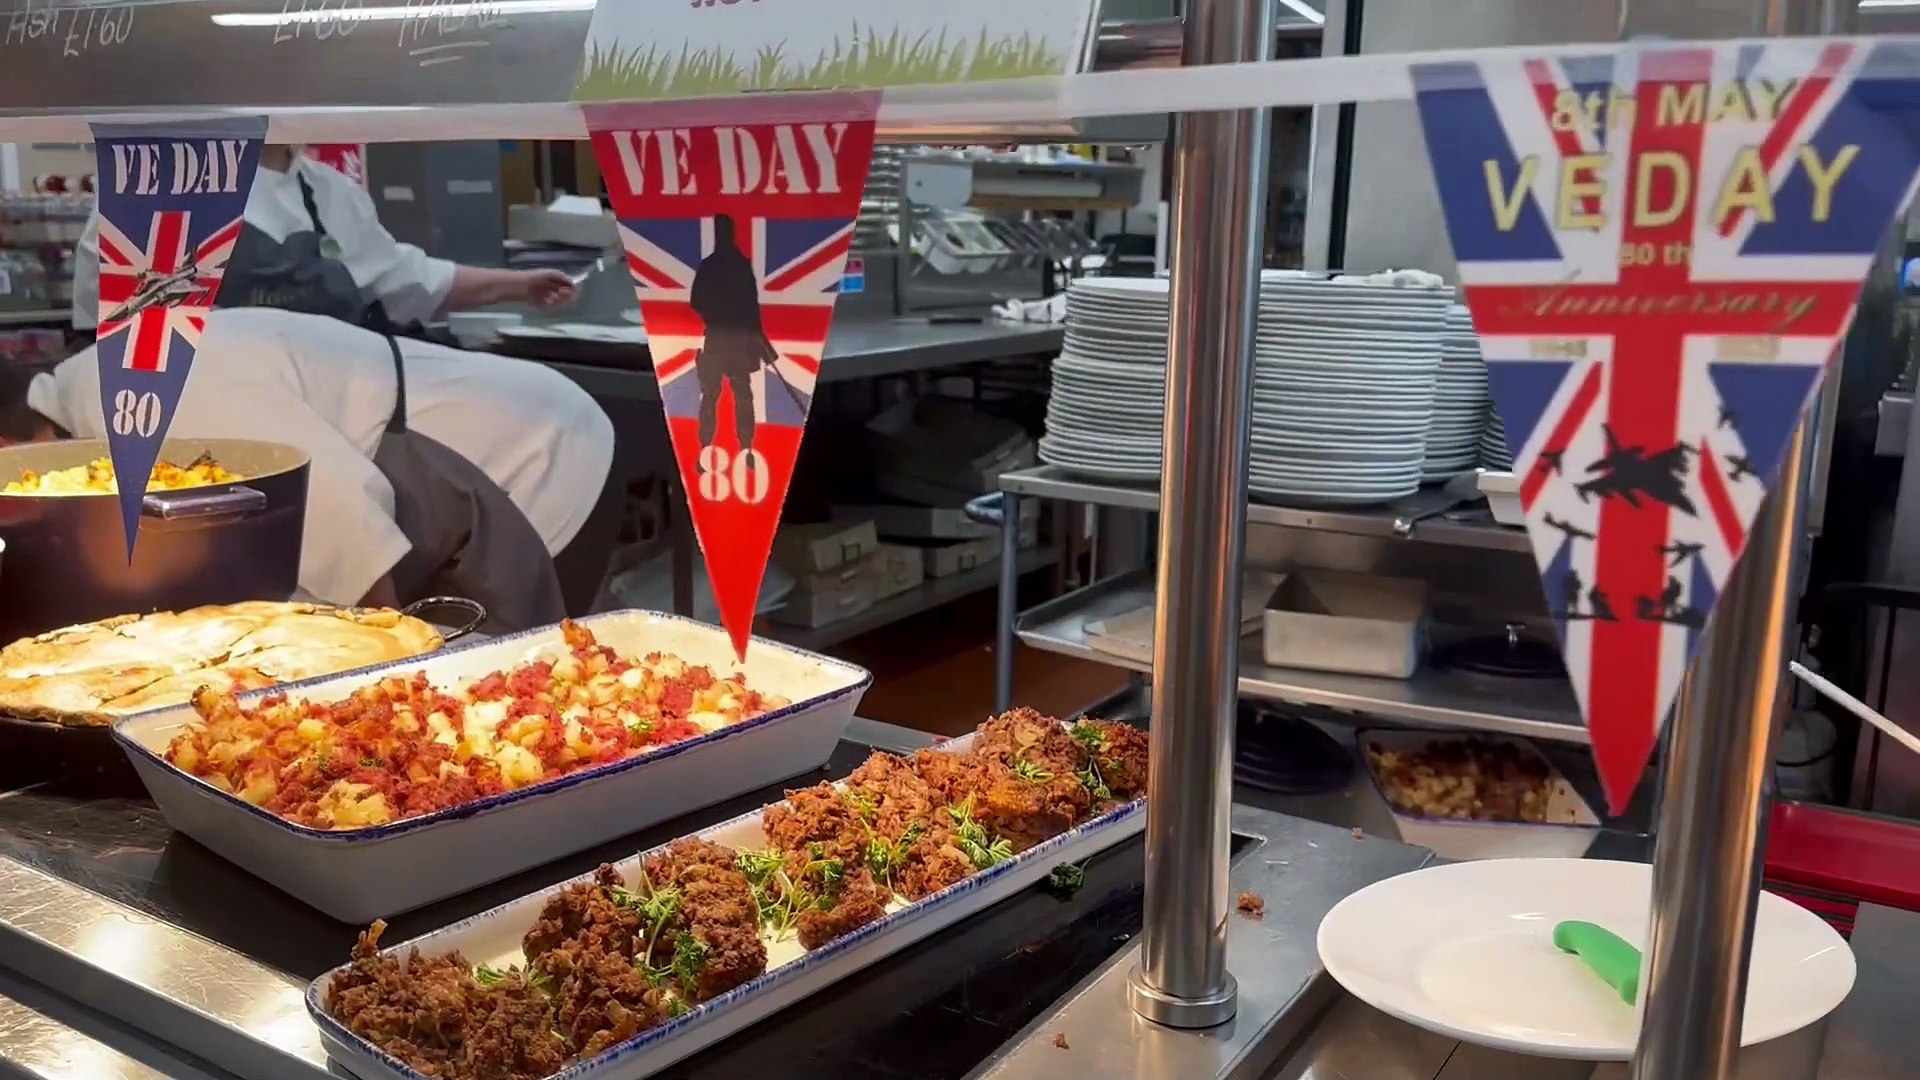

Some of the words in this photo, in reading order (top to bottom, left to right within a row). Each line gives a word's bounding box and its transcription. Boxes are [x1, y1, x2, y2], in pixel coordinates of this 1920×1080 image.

[1656, 78, 1798, 127] MAY
[112, 144, 160, 195] VE
[170, 140, 248, 194] DAY
[611, 128, 698, 196] VE
[713, 122, 848, 195] DAY
[1499, 269, 1818, 336] Anniversary
[113, 389, 162, 438] 80
[698, 445, 770, 504] 80
